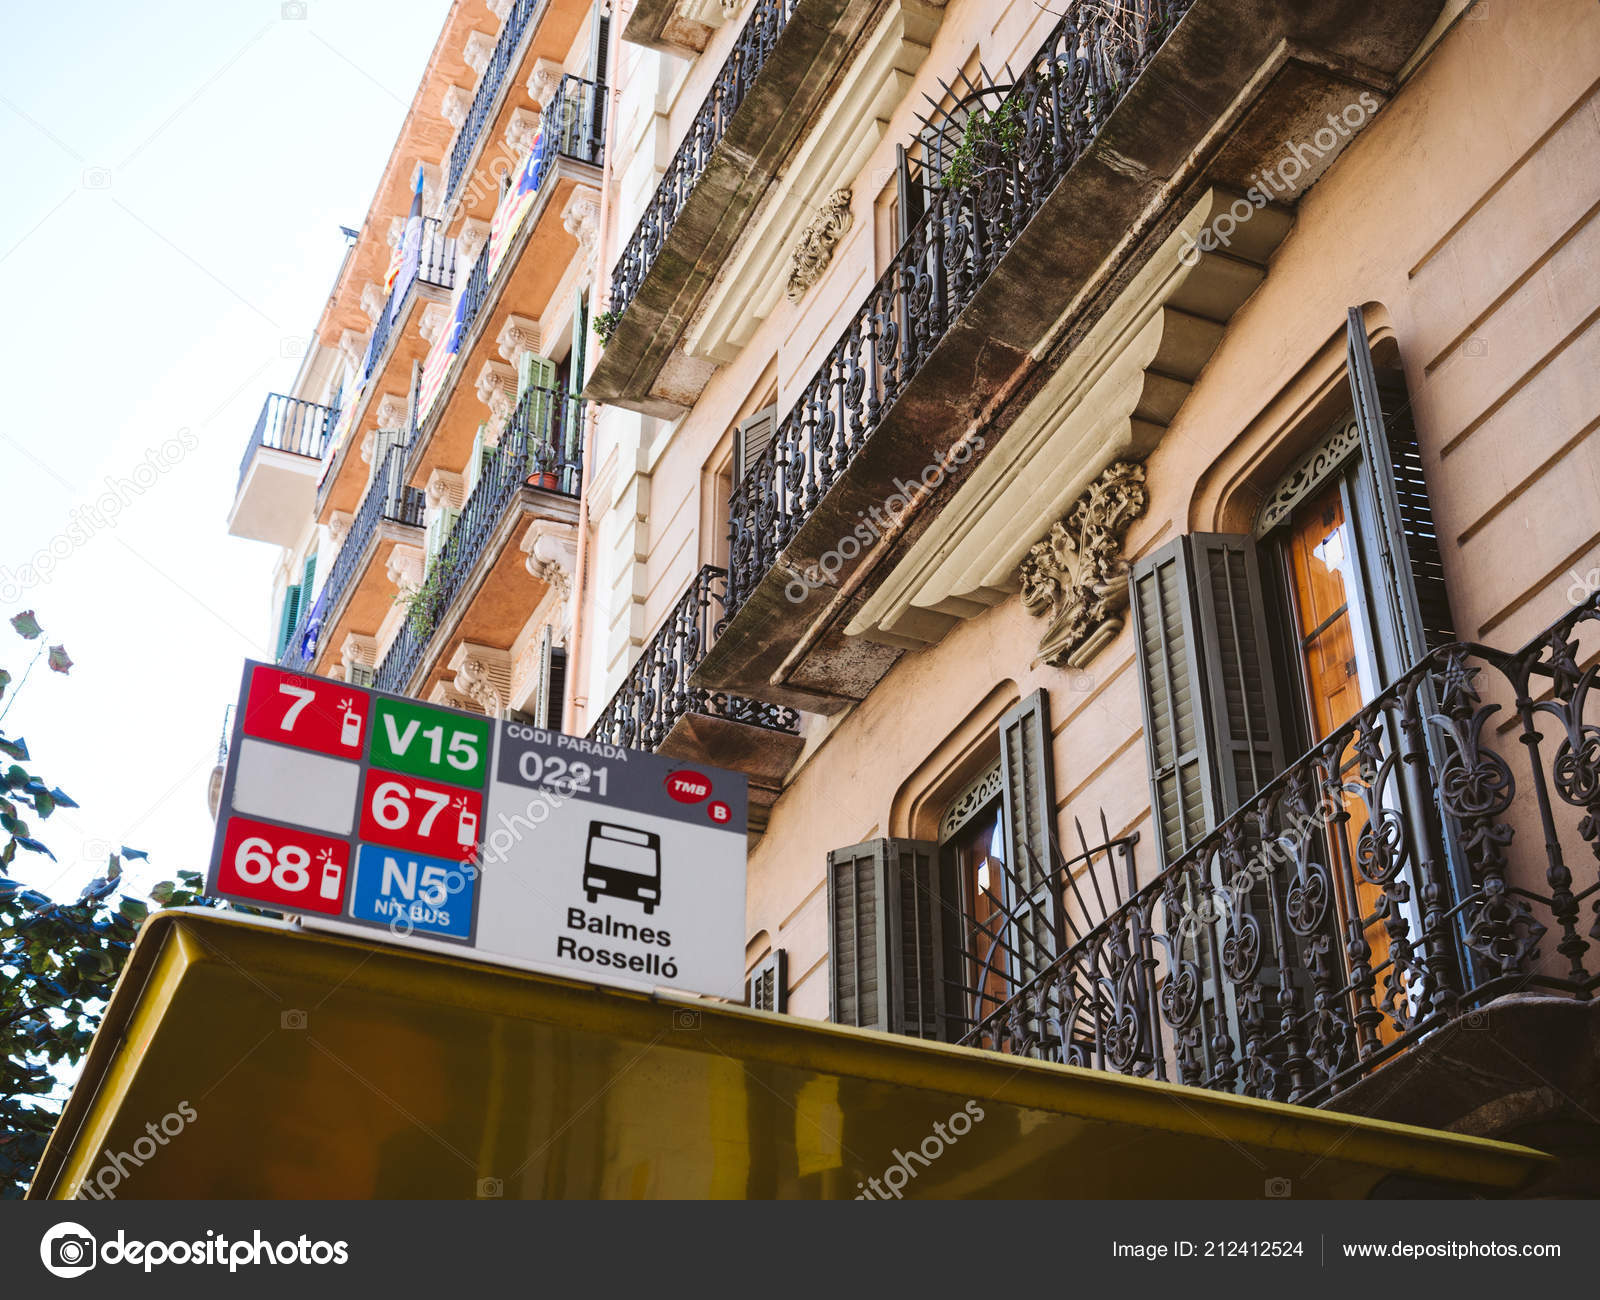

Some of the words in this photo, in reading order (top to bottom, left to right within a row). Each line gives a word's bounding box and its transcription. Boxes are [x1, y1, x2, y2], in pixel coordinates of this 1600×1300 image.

[279, 684, 315, 731] 7
[383, 713, 478, 771] V15
[507, 725, 551, 745] CODI
[557, 737, 628, 762] PARADA
[519, 751, 608, 796] 0221
[674, 780, 706, 796] TMB
[372, 782, 450, 837] 67
[714, 806, 727, 820] B
[235, 837, 310, 892] 68
[380, 857, 448, 905] N5
[374, 899, 406, 919] NIT
[410, 905, 450, 926] BUS
[567, 907, 671, 947] Balmes
[557, 936, 678, 979] Rosselló
